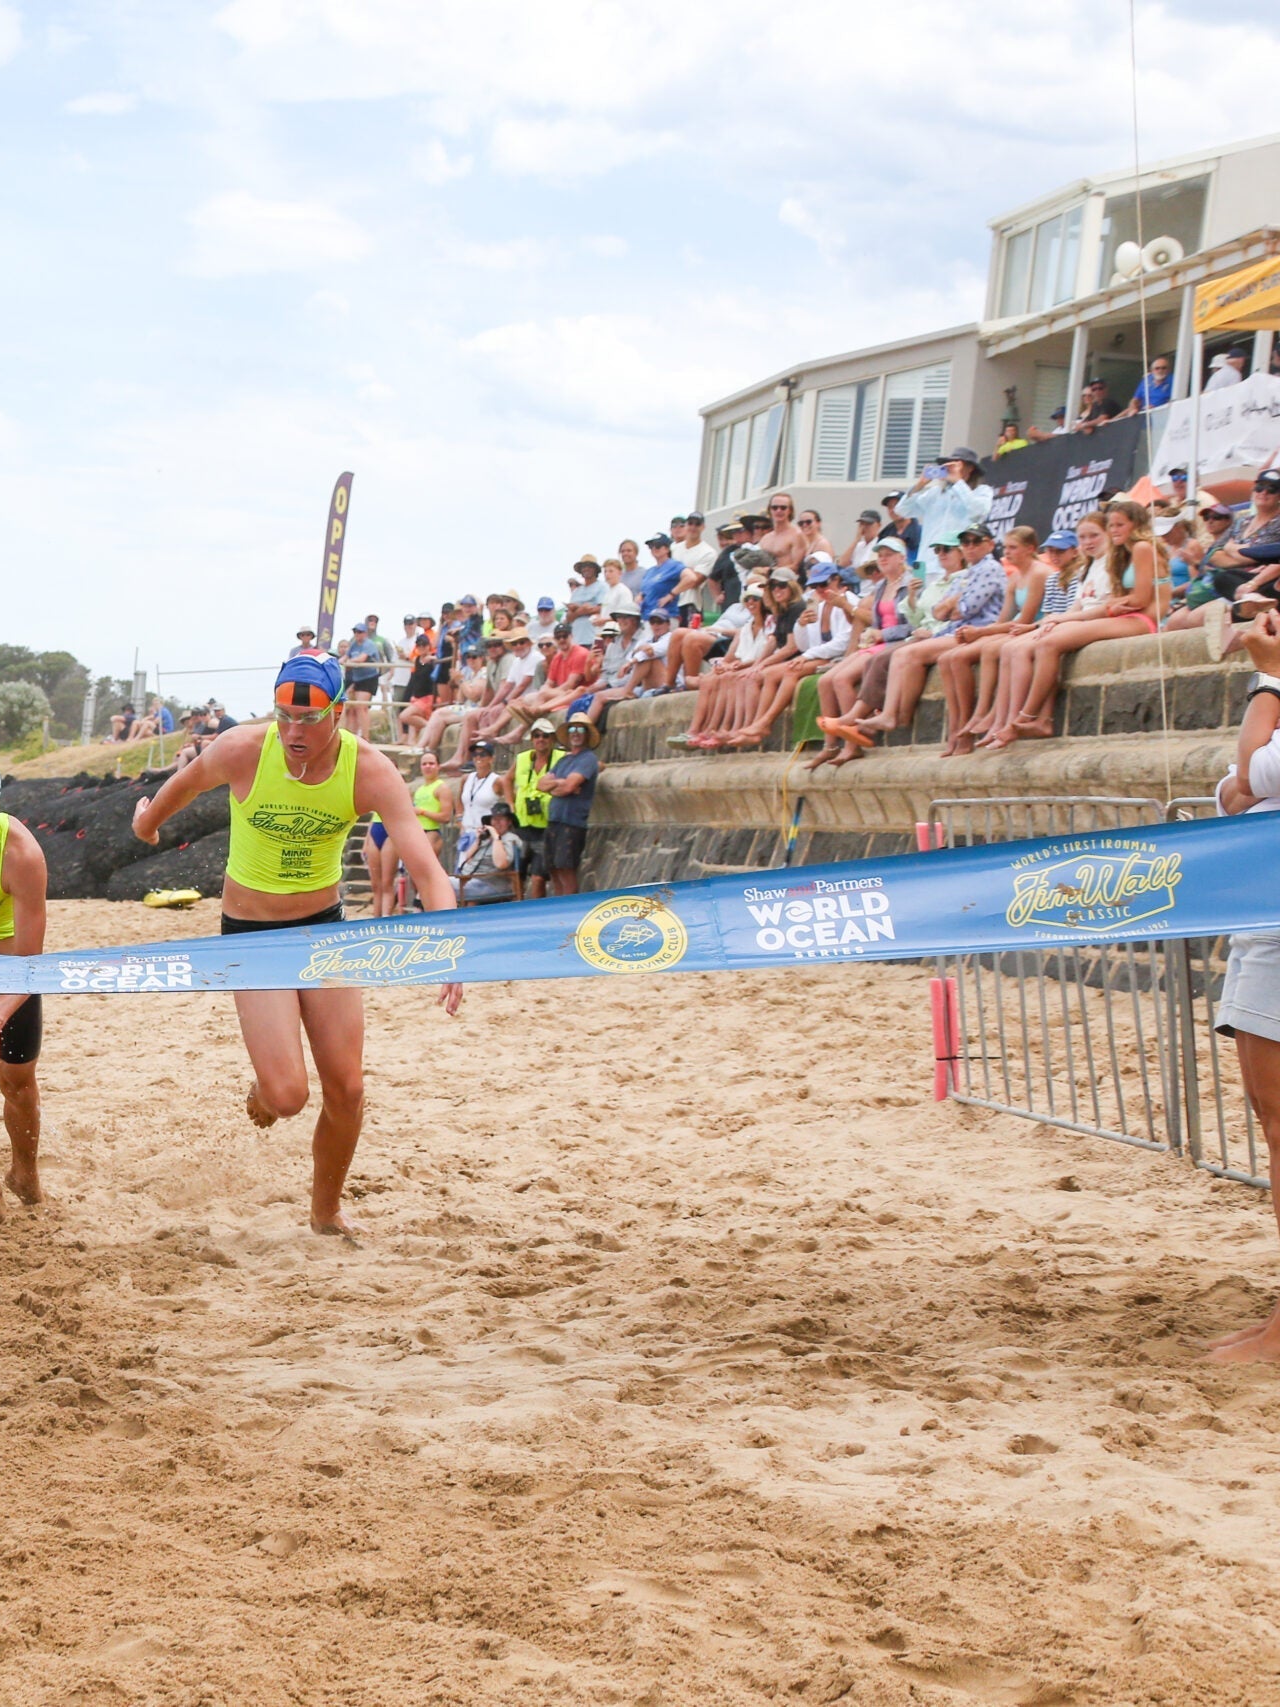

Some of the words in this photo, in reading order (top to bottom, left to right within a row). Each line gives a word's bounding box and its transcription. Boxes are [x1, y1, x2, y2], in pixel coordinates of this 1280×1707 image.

[321, 486, 348, 616] OPEN
[1063, 839, 1096, 853] FIRST
[1100, 838, 1157, 853] IRONMAN
[746, 891, 890, 927] WORLD
[359, 925, 389, 937] FIRST
[394, 924, 445, 937] IRONMAN
[756, 915, 896, 951] OCEAN
[583, 936, 600, 957] SURF
[598, 957, 623, 969] LIFE
[628, 953, 672, 970] SAVING
[667, 927, 679, 951] CLUB
[794, 945, 865, 959] SERIES
[59, 962, 192, 978] WORLD
[60, 975, 192, 989] OCEAN
